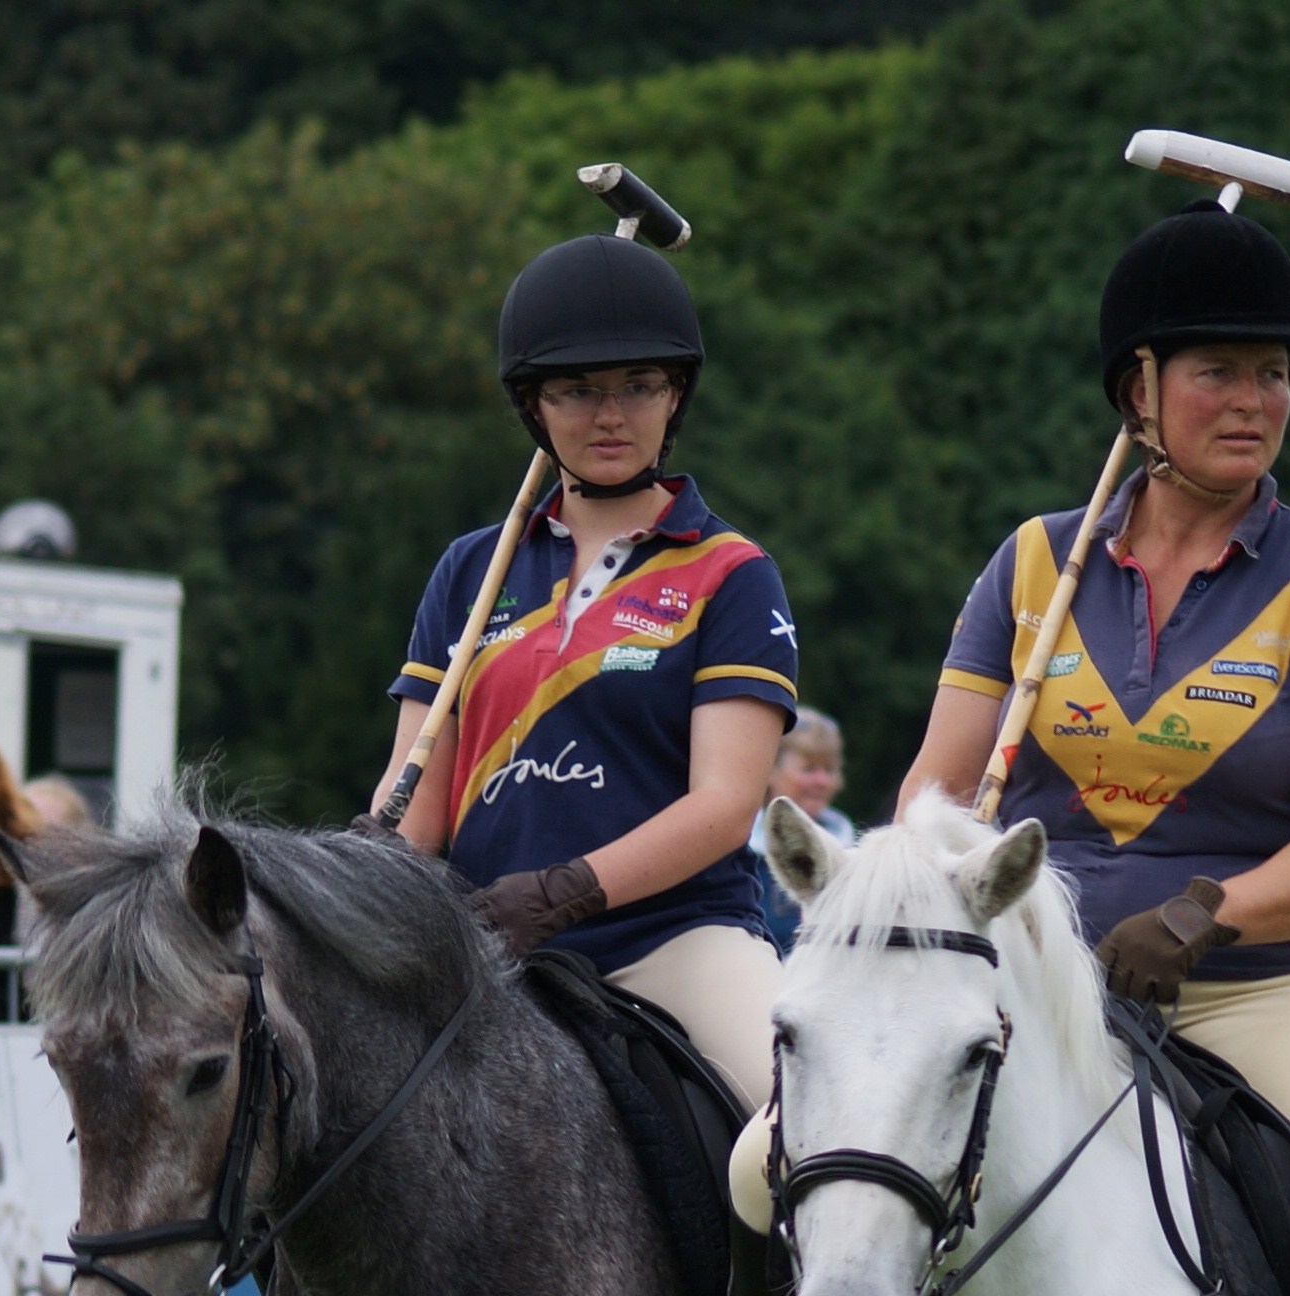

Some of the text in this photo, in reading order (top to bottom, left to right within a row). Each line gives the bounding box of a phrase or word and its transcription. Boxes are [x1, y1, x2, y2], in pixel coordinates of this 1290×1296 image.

[613, 612, 673, 640] MALCOLM
[603, 646, 659, 664] Baileys
[1189, 687, 1253, 706] BRUADAR
